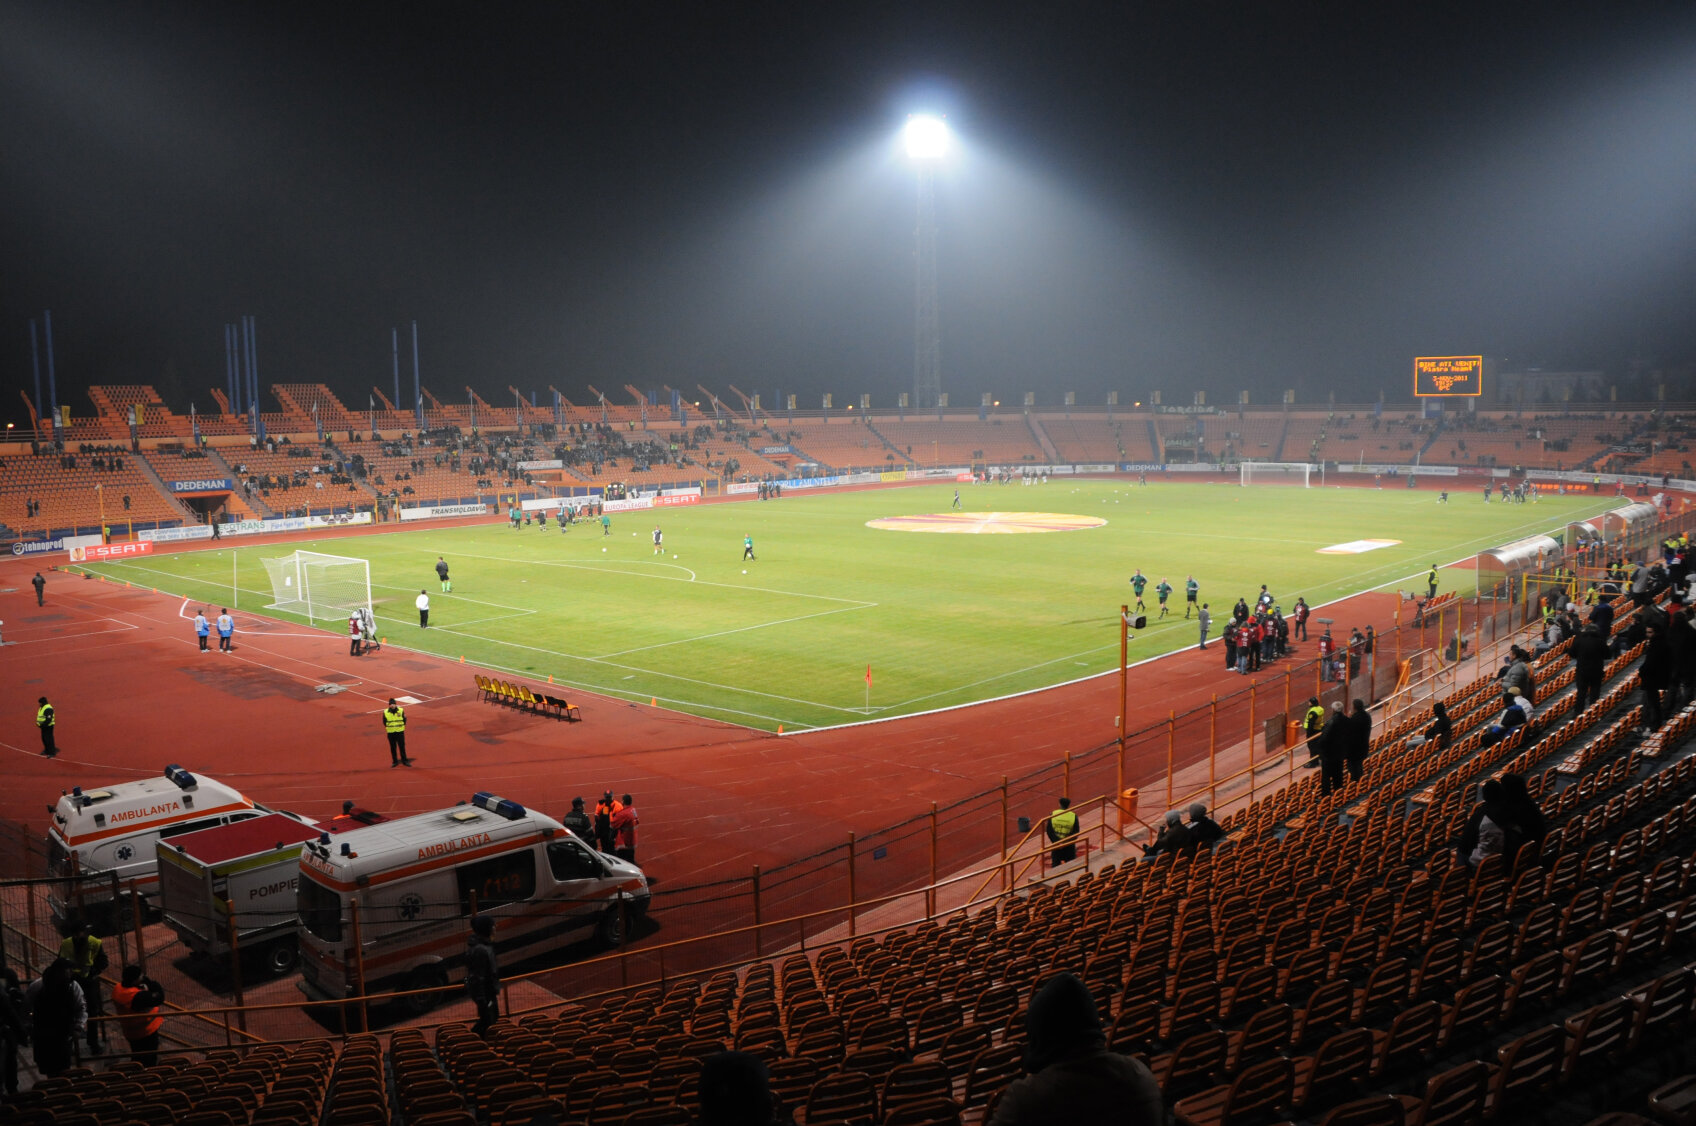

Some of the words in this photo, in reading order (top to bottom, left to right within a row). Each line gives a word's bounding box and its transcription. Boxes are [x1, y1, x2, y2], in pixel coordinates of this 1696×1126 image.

[175, 479, 226, 492] DEDEMAN
[605, 503, 626, 511] EUROPA
[628, 501, 649, 509] LEAGUE
[663, 495, 697, 504] SEAT
[430, 504, 487, 516] TRANSMOLDAVIA
[218, 520, 266, 532] ECOTRANS
[23, 539, 63, 552] tehnoprod
[97, 542, 149, 556] SEAT
[303, 852, 335, 876] AMULANTA
[249, 877, 299, 900] POMPIE
[495, 872, 521, 894] 112
